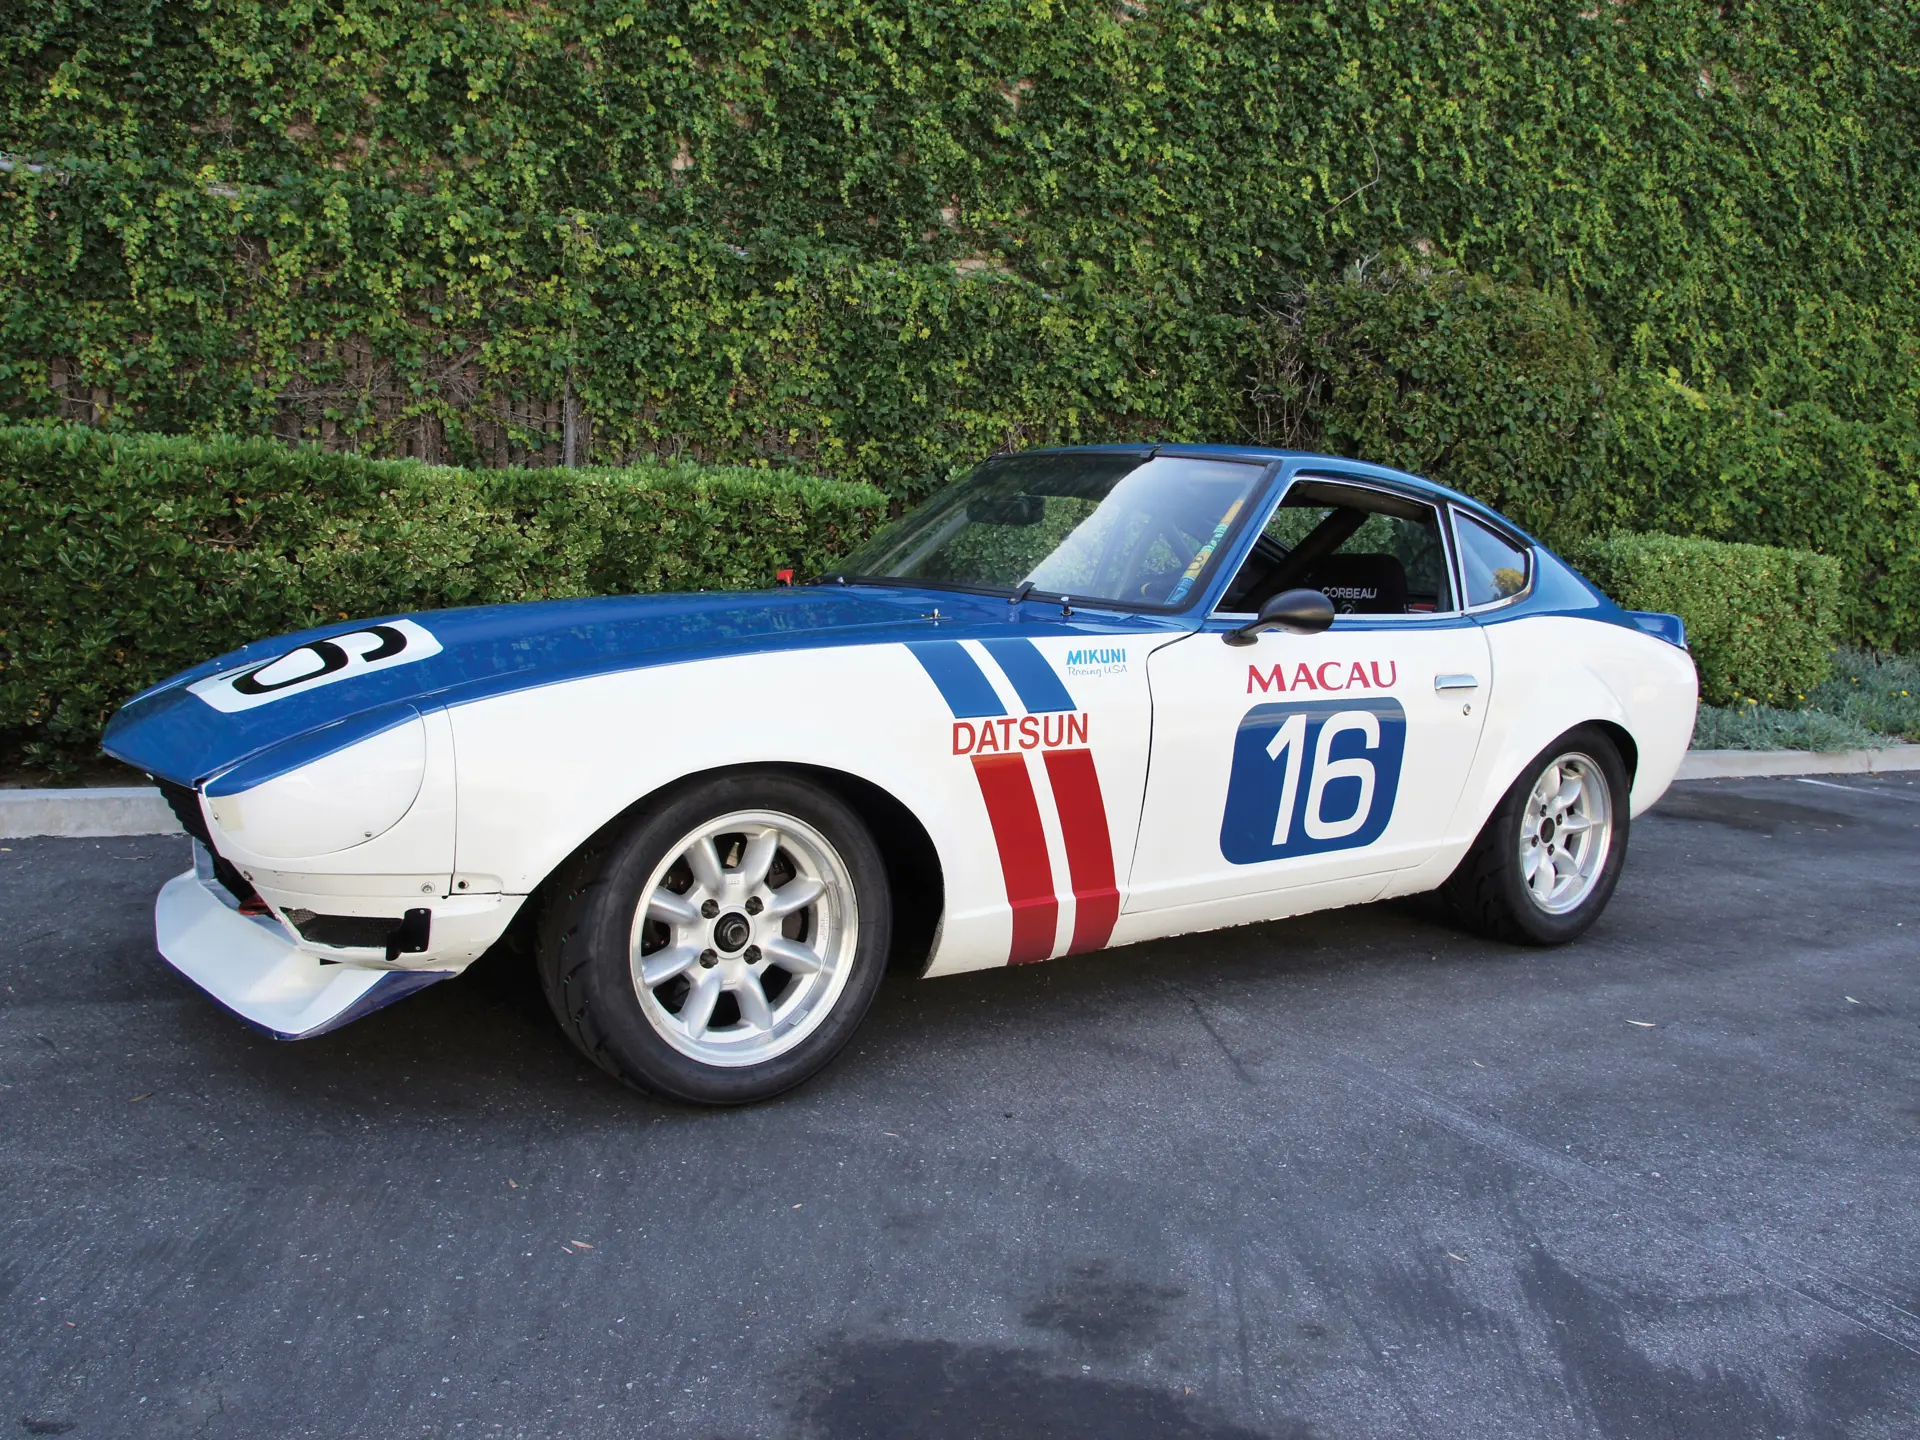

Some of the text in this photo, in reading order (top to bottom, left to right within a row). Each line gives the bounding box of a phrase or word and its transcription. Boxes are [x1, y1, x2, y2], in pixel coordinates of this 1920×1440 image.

[1322, 587, 1377, 599] CORBEAU
[1066, 648, 1126, 665] MIKUNI
[1067, 664, 1128, 678] Racing USA
[1246, 660, 1397, 694] MACAU
[952, 713, 1088, 755] DATSUN
[1265, 710, 1380, 846] 16
